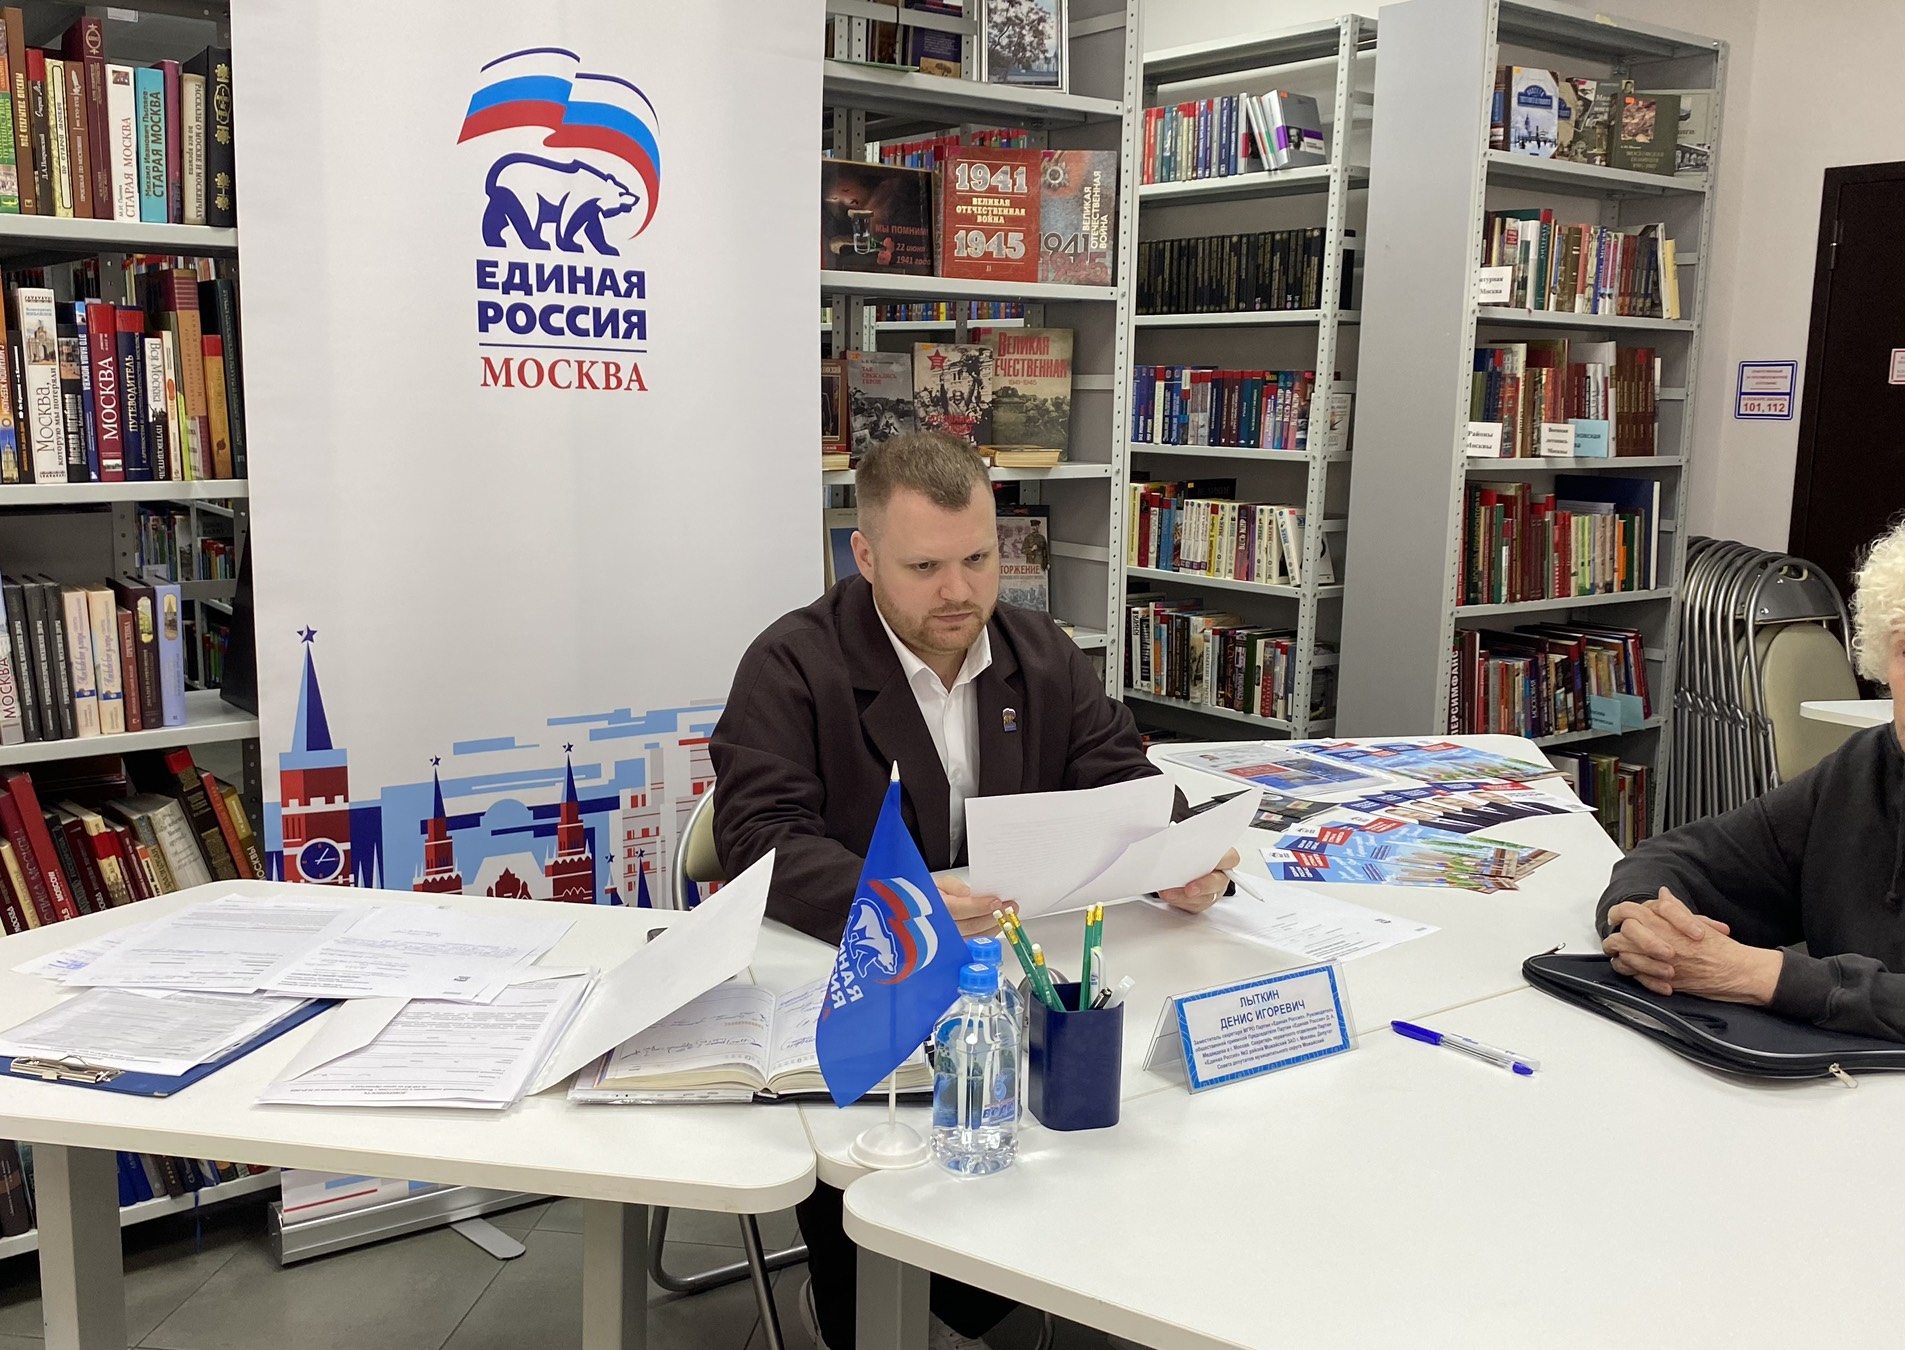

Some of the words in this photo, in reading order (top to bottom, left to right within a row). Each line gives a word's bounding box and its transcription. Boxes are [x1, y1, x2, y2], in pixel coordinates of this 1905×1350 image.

[142, 91, 150, 122] Пыляев
[149, 91, 162, 145] МОСКВА
[121, 117, 133, 167] МОСКВА
[143, 124, 151, 164] Иванович
[151, 149, 164, 198] СТАРАЯ
[955, 163, 1028, 193] 1941
[124, 173, 136, 218] СТАРАЯ
[956, 206, 1026, 216] ОТЕЧЕСТВЕННАЯ
[972, 197, 1011, 207] ВЕЛИКАЯ
[1082, 186, 1092, 231] ВЕЛИКАЯ
[1091, 171, 1101, 249] ОТЕЧЕСТВЕННАЯ
[875, 224, 889, 232] МЫ
[892, 225, 929, 235] ПОМНИМ!
[976, 215, 1005, 224] ВОЙНА
[1099, 215, 1108, 249] ВОЙНА
[896, 256, 913, 265] 1941
[954, 230, 1026, 259] 1945
[476, 259, 646, 299] ЕДИНАЯ
[478, 300, 647, 340] РОССИЯ
[78, 334, 87, 345] ЭТО
[80, 346, 88, 365] НАША
[149, 342, 162, 361] Вся
[998, 332, 1050, 358] ВЕЛИКАЯ
[81, 365, 90, 391] МОСКВА
[152, 364, 163, 403] Москва
[480, 357, 648, 391] МОСКВА
[994, 357, 1068, 378] ЕЧЕСТВЕННАЯ
[50, 367, 59, 410] потеряли
[98, 356, 119, 441] МОСКВА
[125, 354, 138, 432] ПУТЕВОДИТЕЛЬ
[35, 381, 55, 453] Москва,
[54, 412, 60, 426] мы
[64, 393, 78, 432] погибшая
[75, 395, 84, 427] Михайлов
[1743, 403, 1765, 413] 101,
[1767, 403, 1785, 412] 112
[54, 427, 64, 466] которую
[67, 433, 81, 465] Москва
[155, 425, 165, 479] ПУТЕВОДИТЕЛЬ
[1000, 565, 1040, 575] ТОРЖЕНИЕ
[0, 657, 17, 719] МОСКВА
[45, 869, 65, 902] MOSCOW
[5, 904, 21, 933] МОСКВА
[838, 932, 864, 1003] ИНАЯ
[1239, 989, 1280, 1008] ЛЫТКИН
[1220, 1012, 1254, 1031] ДЕНИС
[1255, 1000, 1306, 1020] ИГОРЕВИЧ
